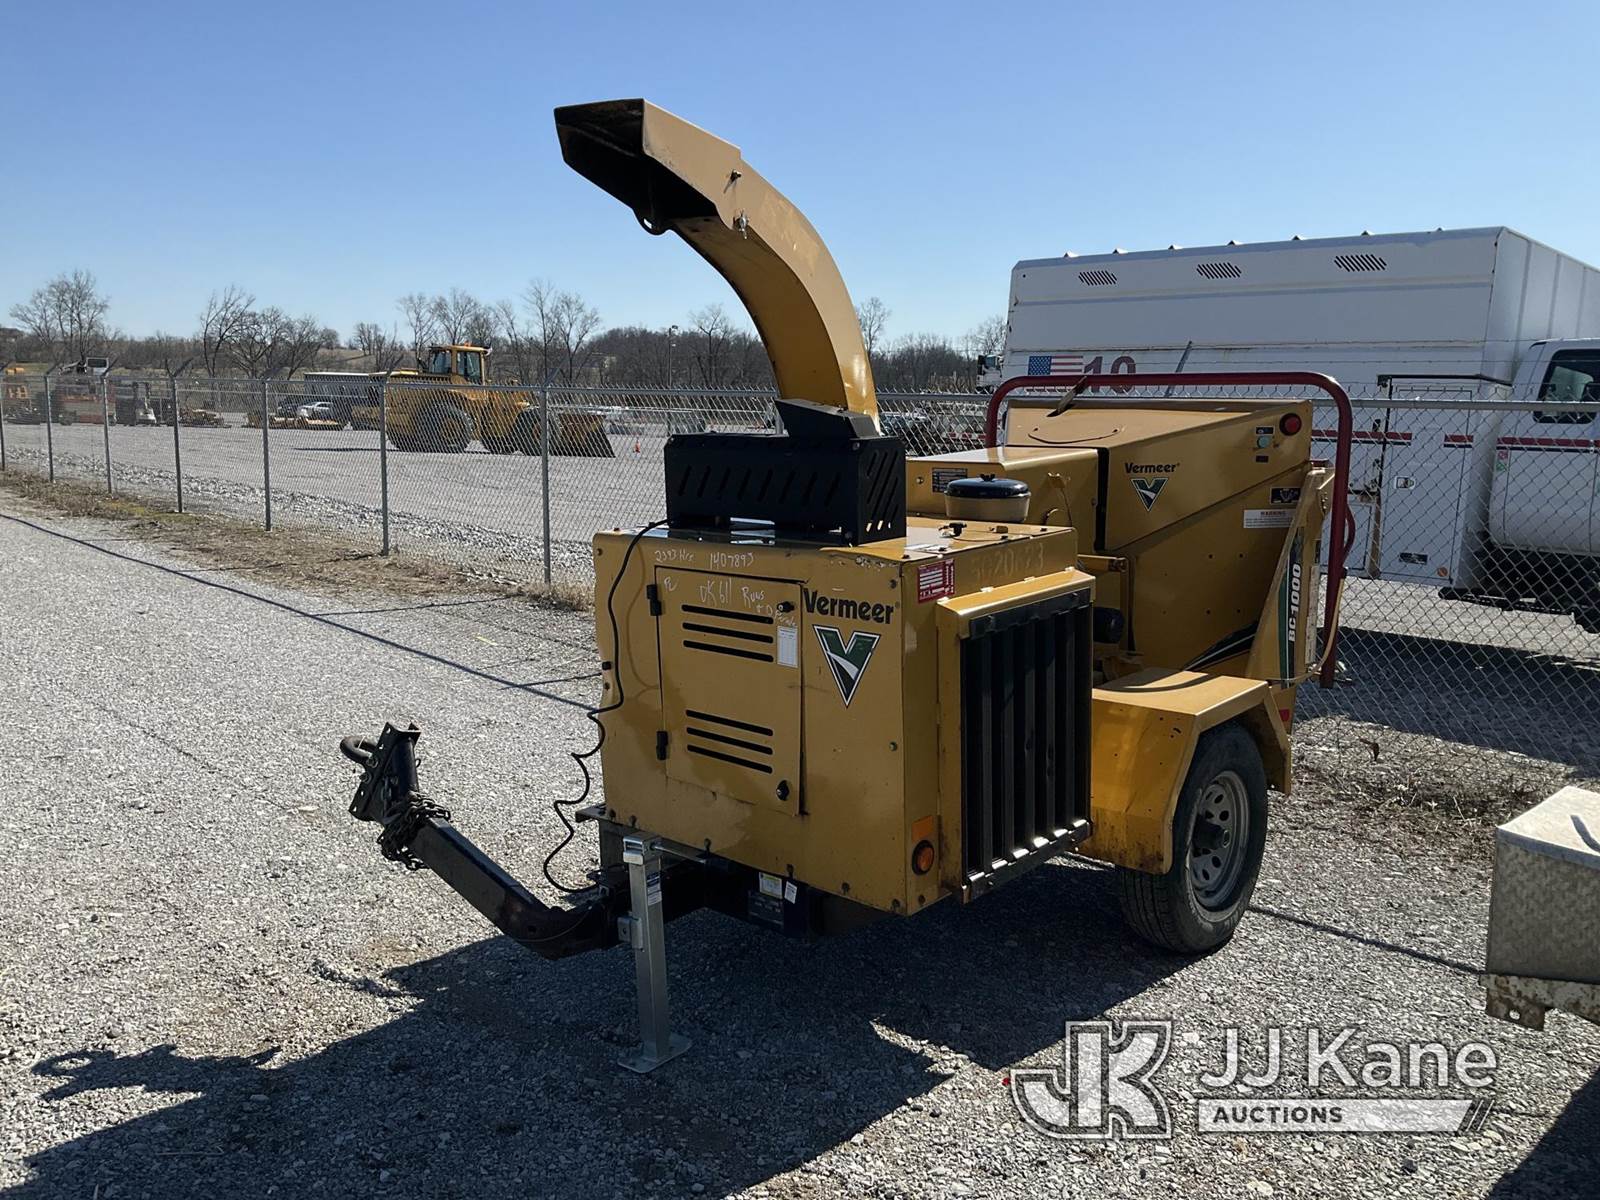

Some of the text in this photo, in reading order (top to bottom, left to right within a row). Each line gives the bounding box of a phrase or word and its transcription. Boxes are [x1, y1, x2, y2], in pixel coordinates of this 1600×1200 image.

[1083, 356, 1136, 393] 10
[1125, 462, 1177, 473] Vermeer
[803, 588, 894, 624] Vermeer
